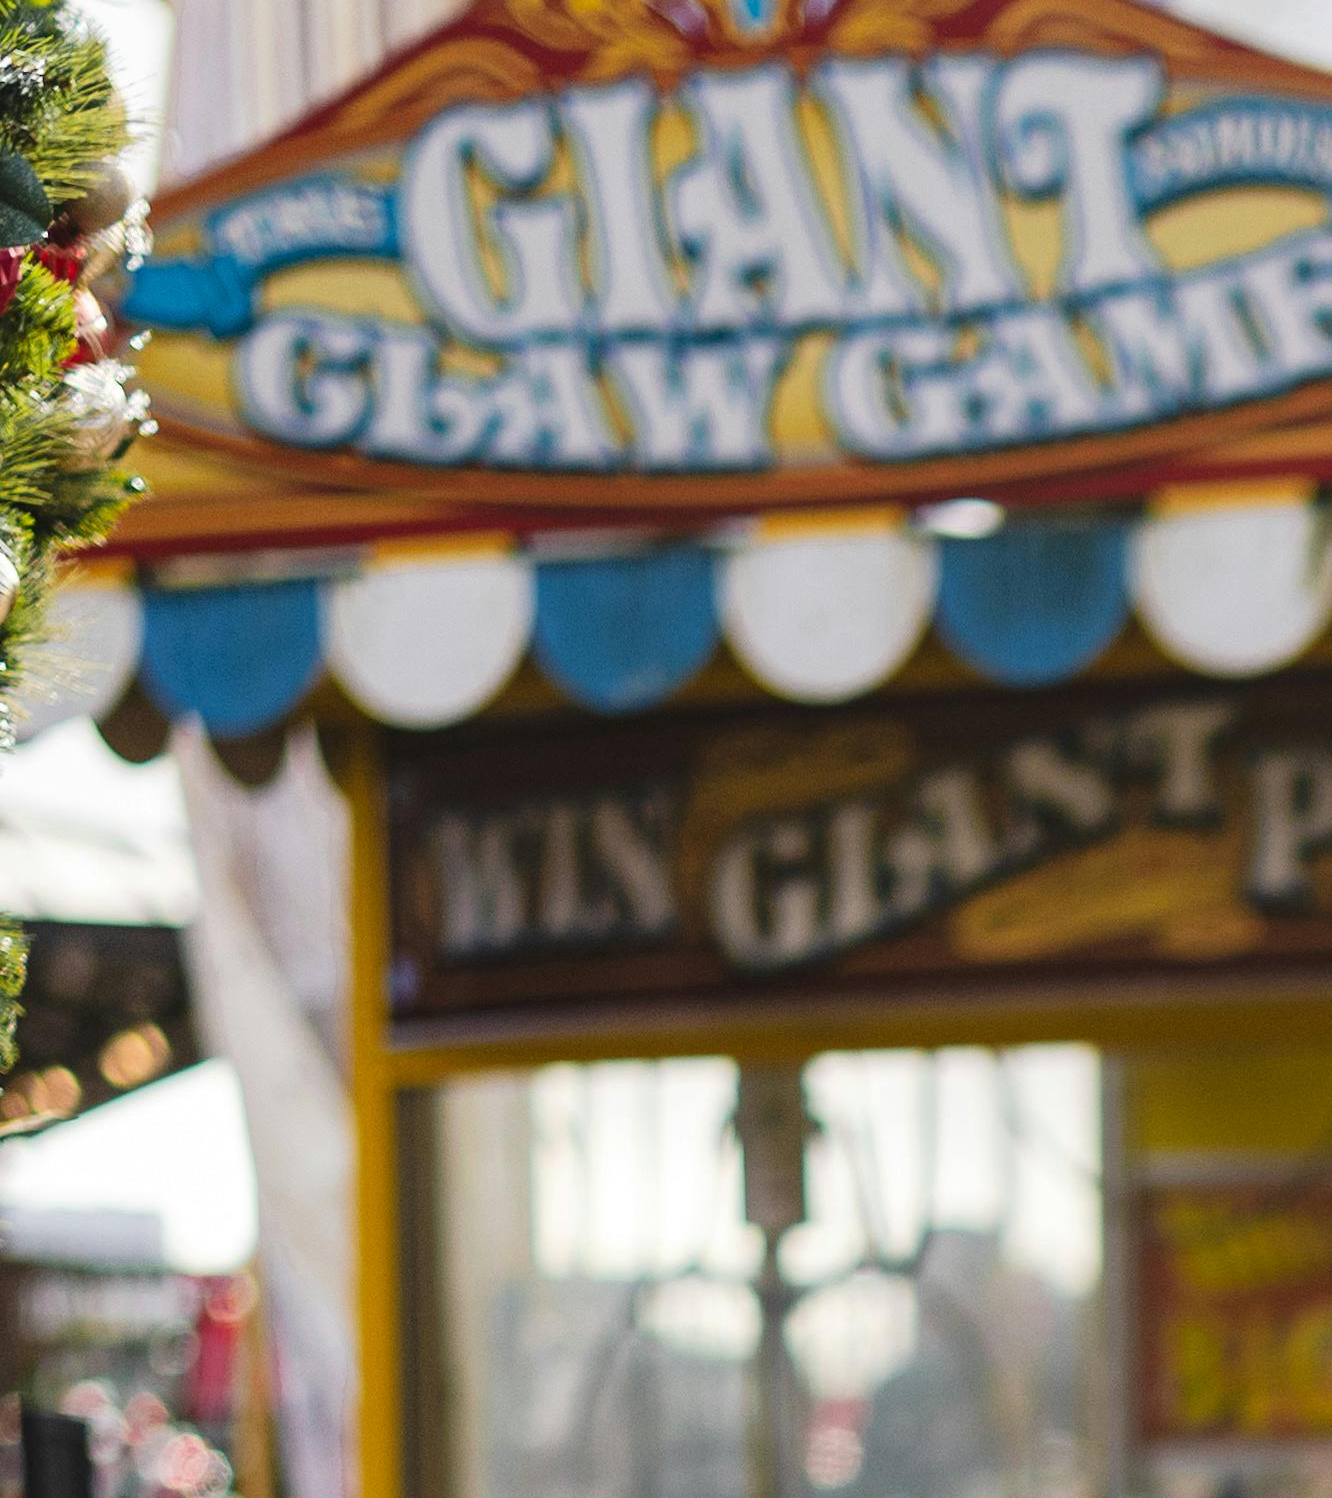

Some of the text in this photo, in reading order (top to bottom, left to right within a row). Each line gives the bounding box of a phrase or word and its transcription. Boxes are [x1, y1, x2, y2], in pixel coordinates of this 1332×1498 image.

[402, 49, 1168, 348] GIANT
[232, 312, 784, 470] CLAW
[430, 794, 676, 962] WIN
[704, 700, 1238, 972] GIANT
